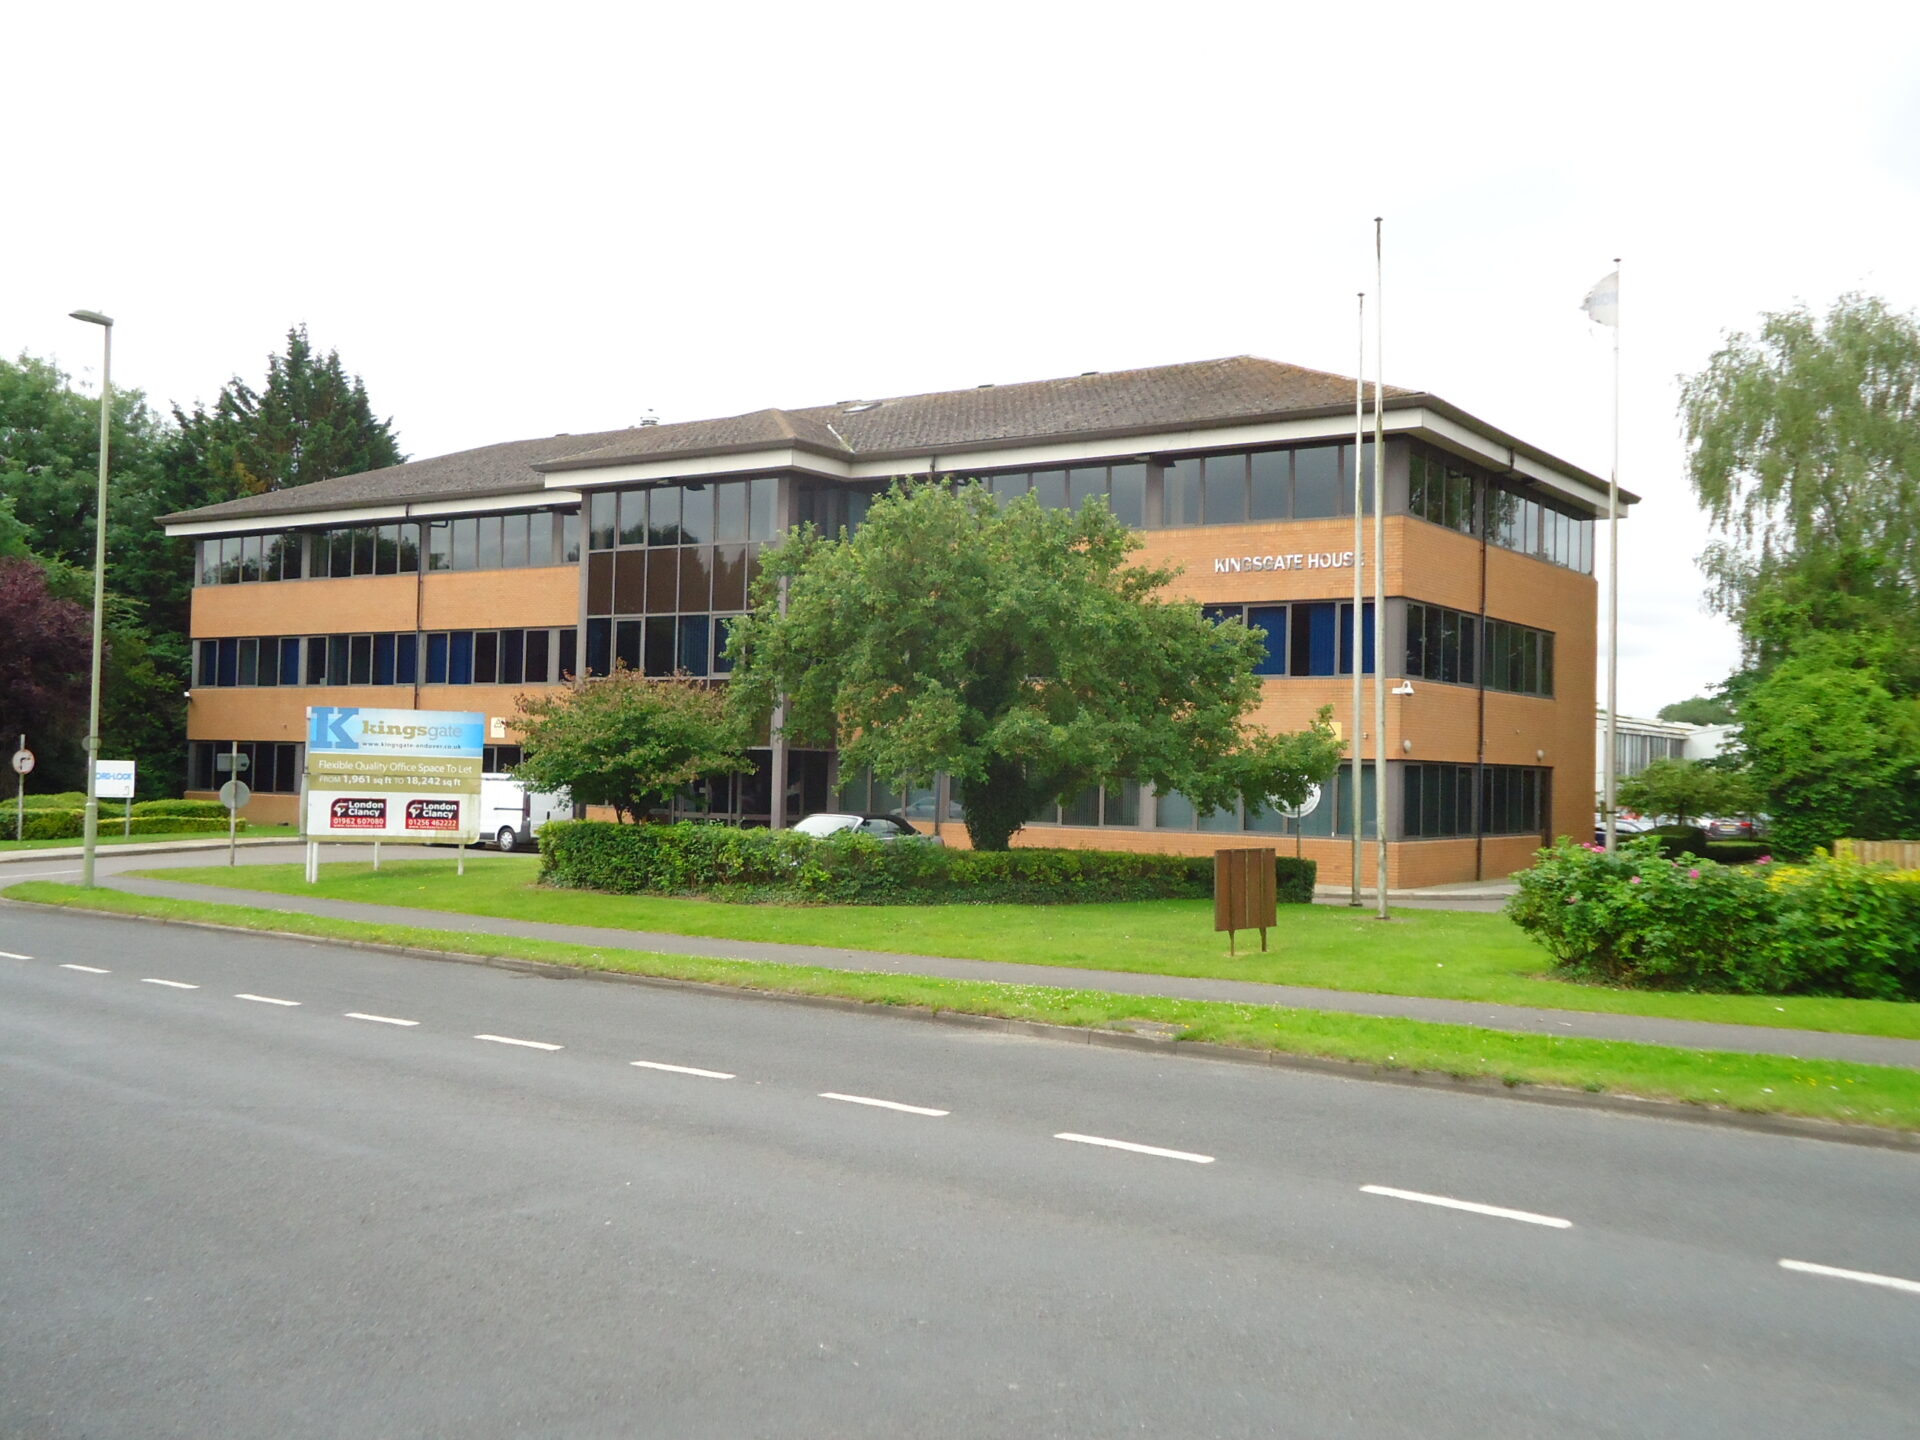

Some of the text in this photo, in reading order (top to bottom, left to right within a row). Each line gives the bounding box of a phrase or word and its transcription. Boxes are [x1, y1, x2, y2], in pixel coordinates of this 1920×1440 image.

[1214, 554, 1303, 573] KINGSGATE
[362, 720, 463, 740] kingsgate
[319, 760, 472, 774] Flexible Quality Office Space To Let
[319, 775, 341, 784] FROM
[343, 775, 371, 784] 1,961
[384, 776, 392, 784] ft
[407, 777, 441, 786] 18,242
[348, 801, 384, 809] London
[423, 803, 457, 811] London
[348, 808, 380, 817] Clancy
[422, 810, 454, 819] Clancy
